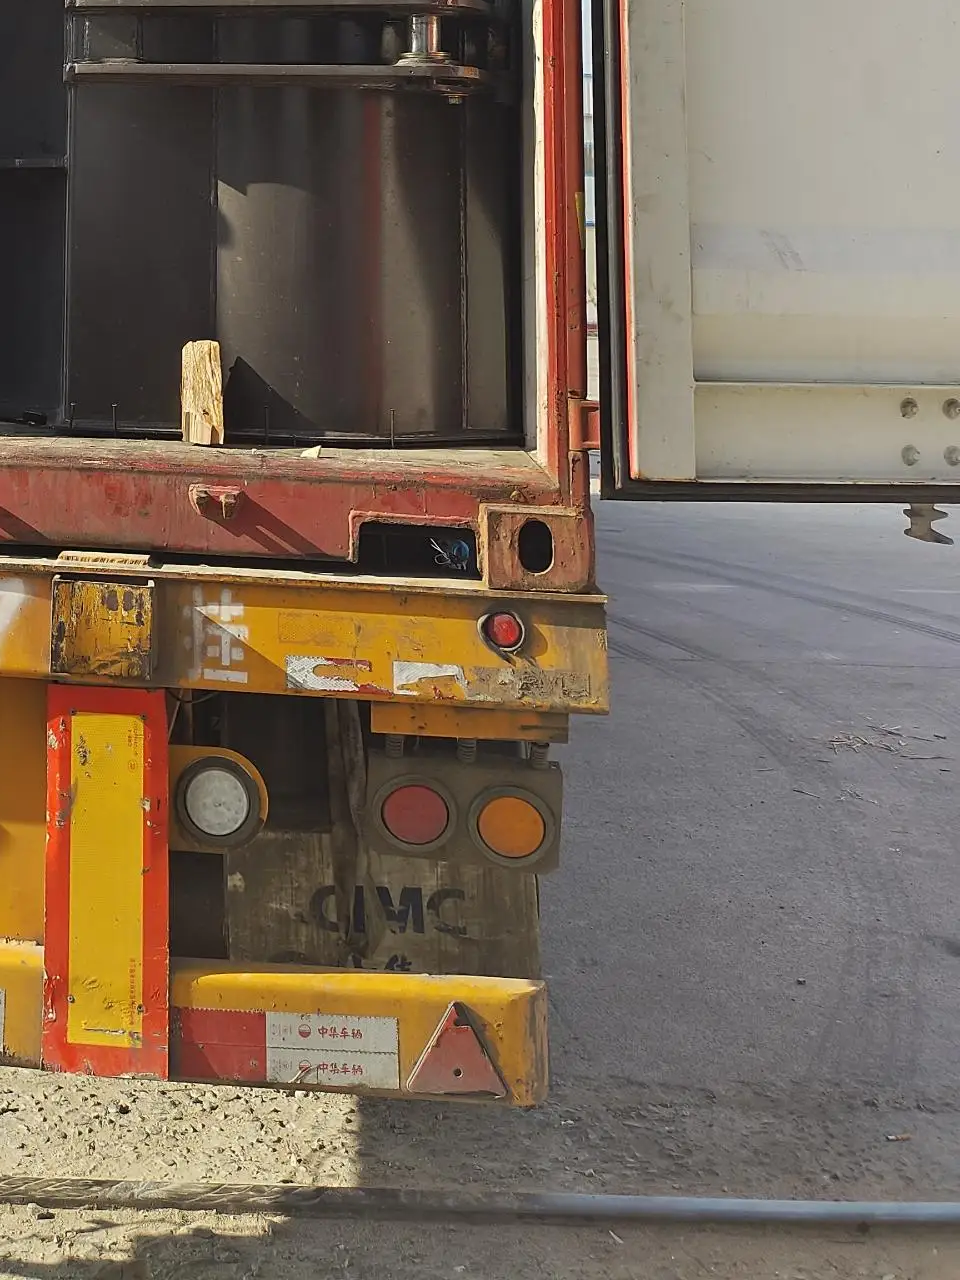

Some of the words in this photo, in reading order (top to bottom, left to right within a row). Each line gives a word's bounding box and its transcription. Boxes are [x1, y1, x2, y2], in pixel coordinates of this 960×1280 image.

[309, 884, 468, 936] CIMC
[317, 1024, 363, 1040] 中集车辆
[318, 1061, 363, 1076] 中集车辆
